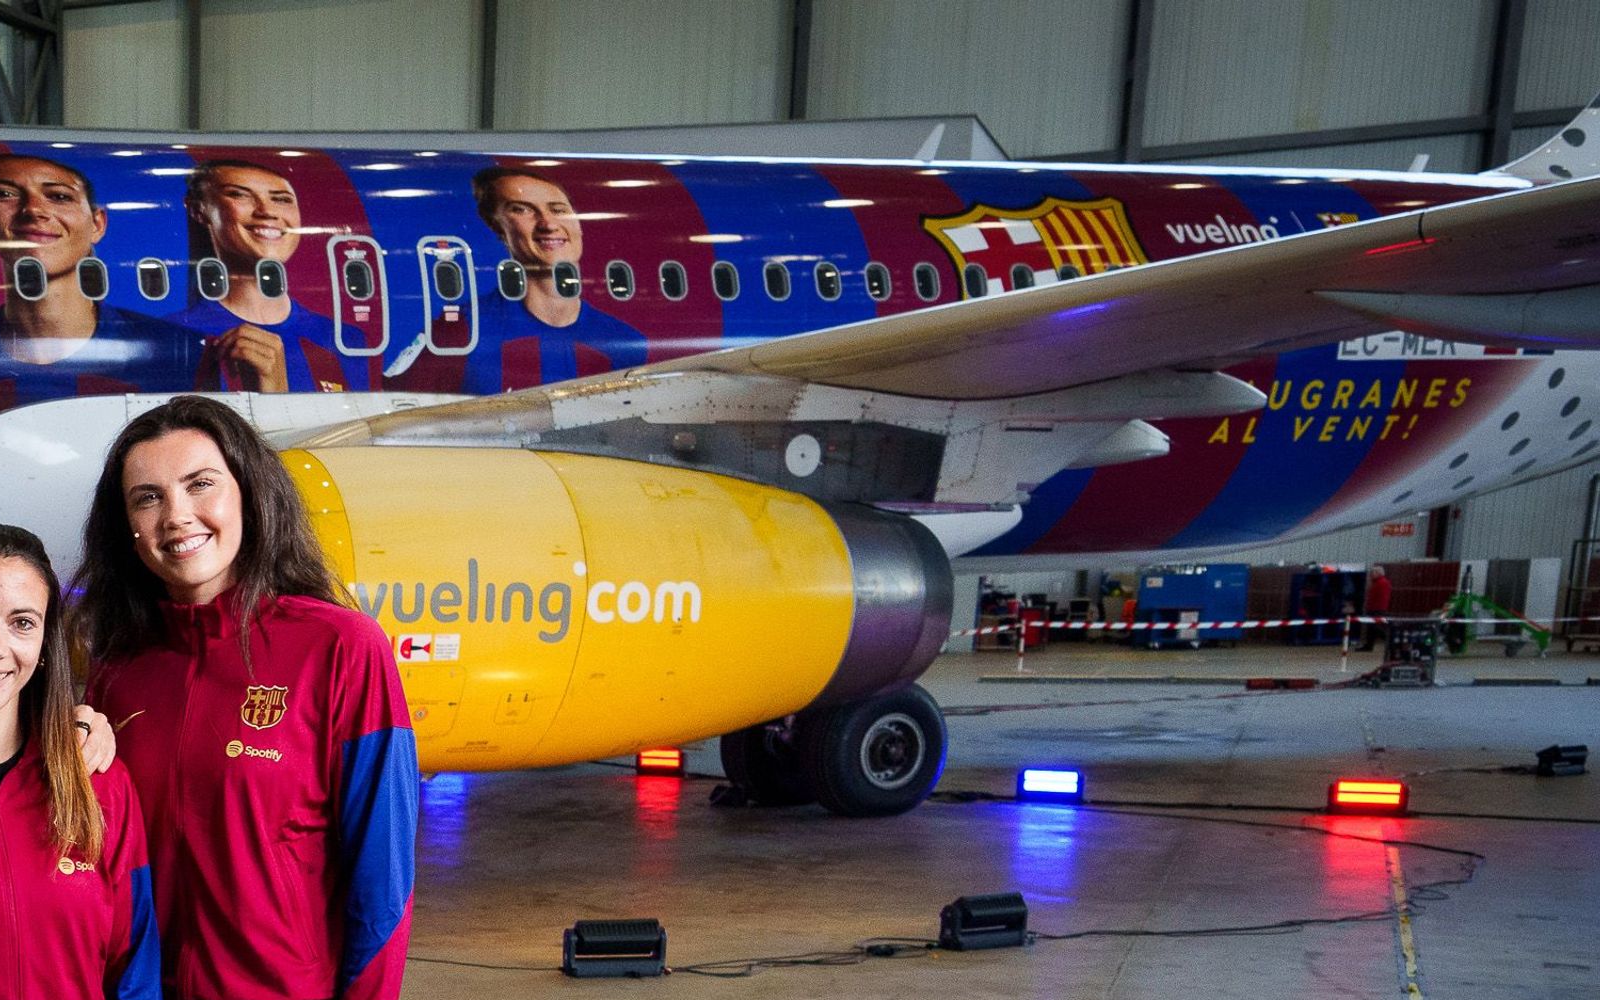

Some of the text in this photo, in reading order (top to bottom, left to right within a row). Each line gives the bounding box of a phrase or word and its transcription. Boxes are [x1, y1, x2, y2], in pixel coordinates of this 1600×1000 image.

[1249, 376, 1472, 411] UGRANES
[1208, 414, 1419, 443] AL VENT!
[245, 745, 282, 762] Spotify
